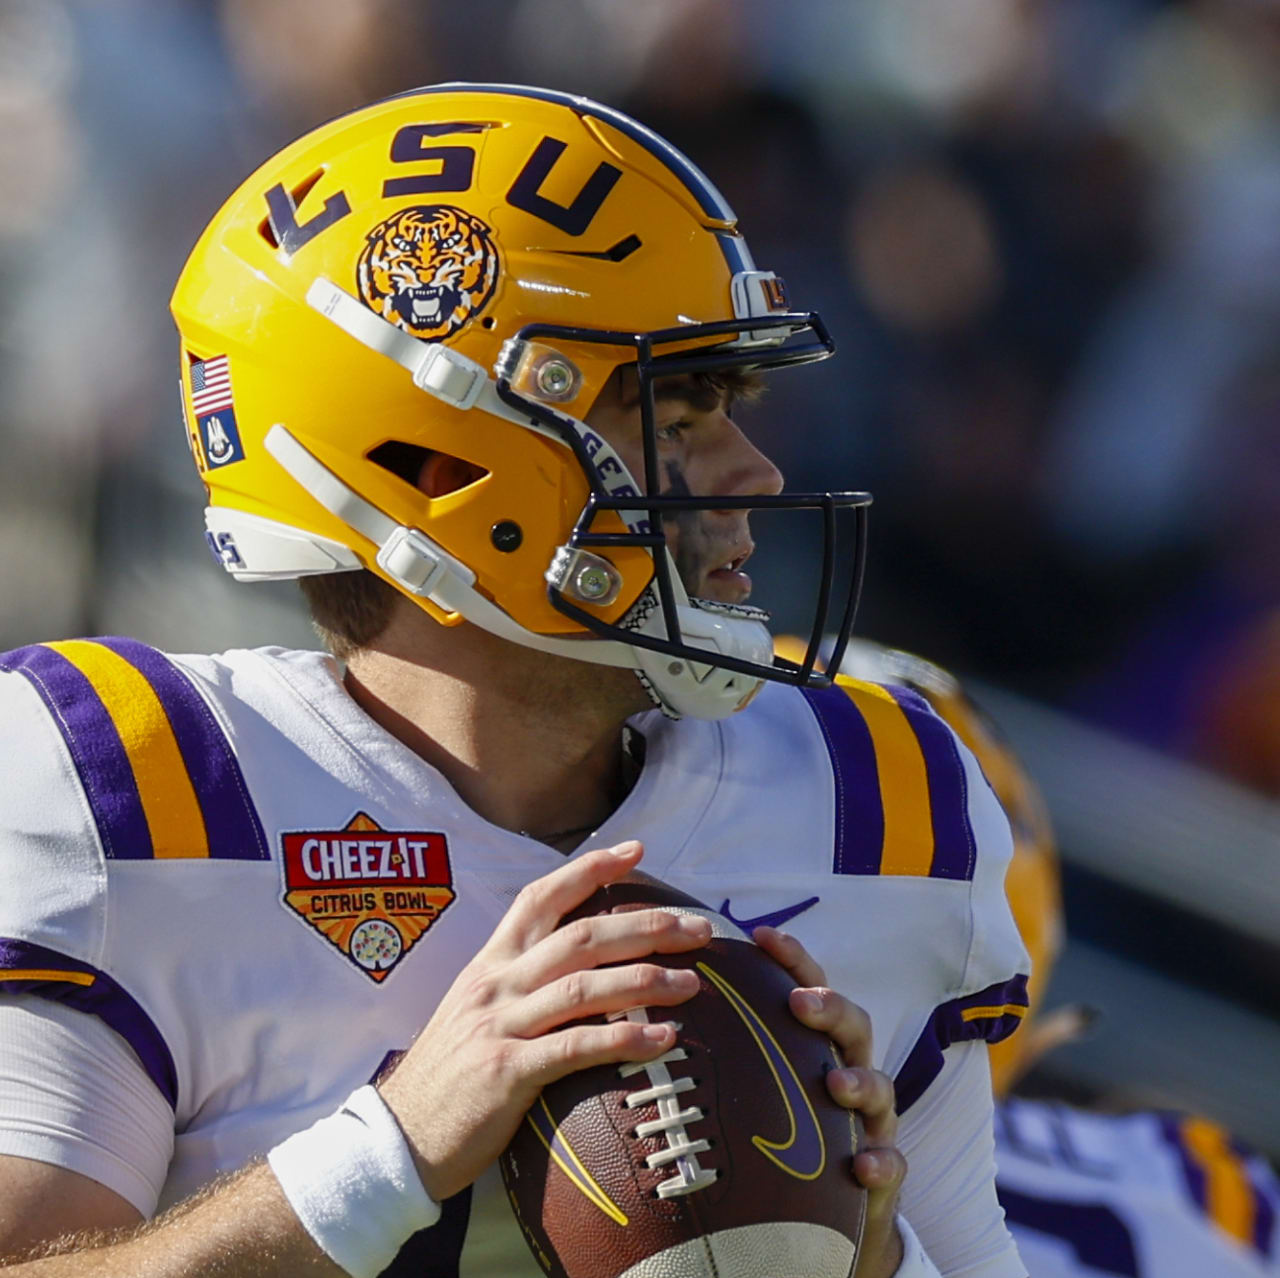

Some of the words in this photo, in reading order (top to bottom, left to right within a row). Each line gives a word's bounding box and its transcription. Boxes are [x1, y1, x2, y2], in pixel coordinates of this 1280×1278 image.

[266, 121, 623, 257] LSU
[301, 837, 430, 881] CHEEZ-IT
[311, 893, 377, 914] CITRUS
[383, 891, 434, 911] BOWL
